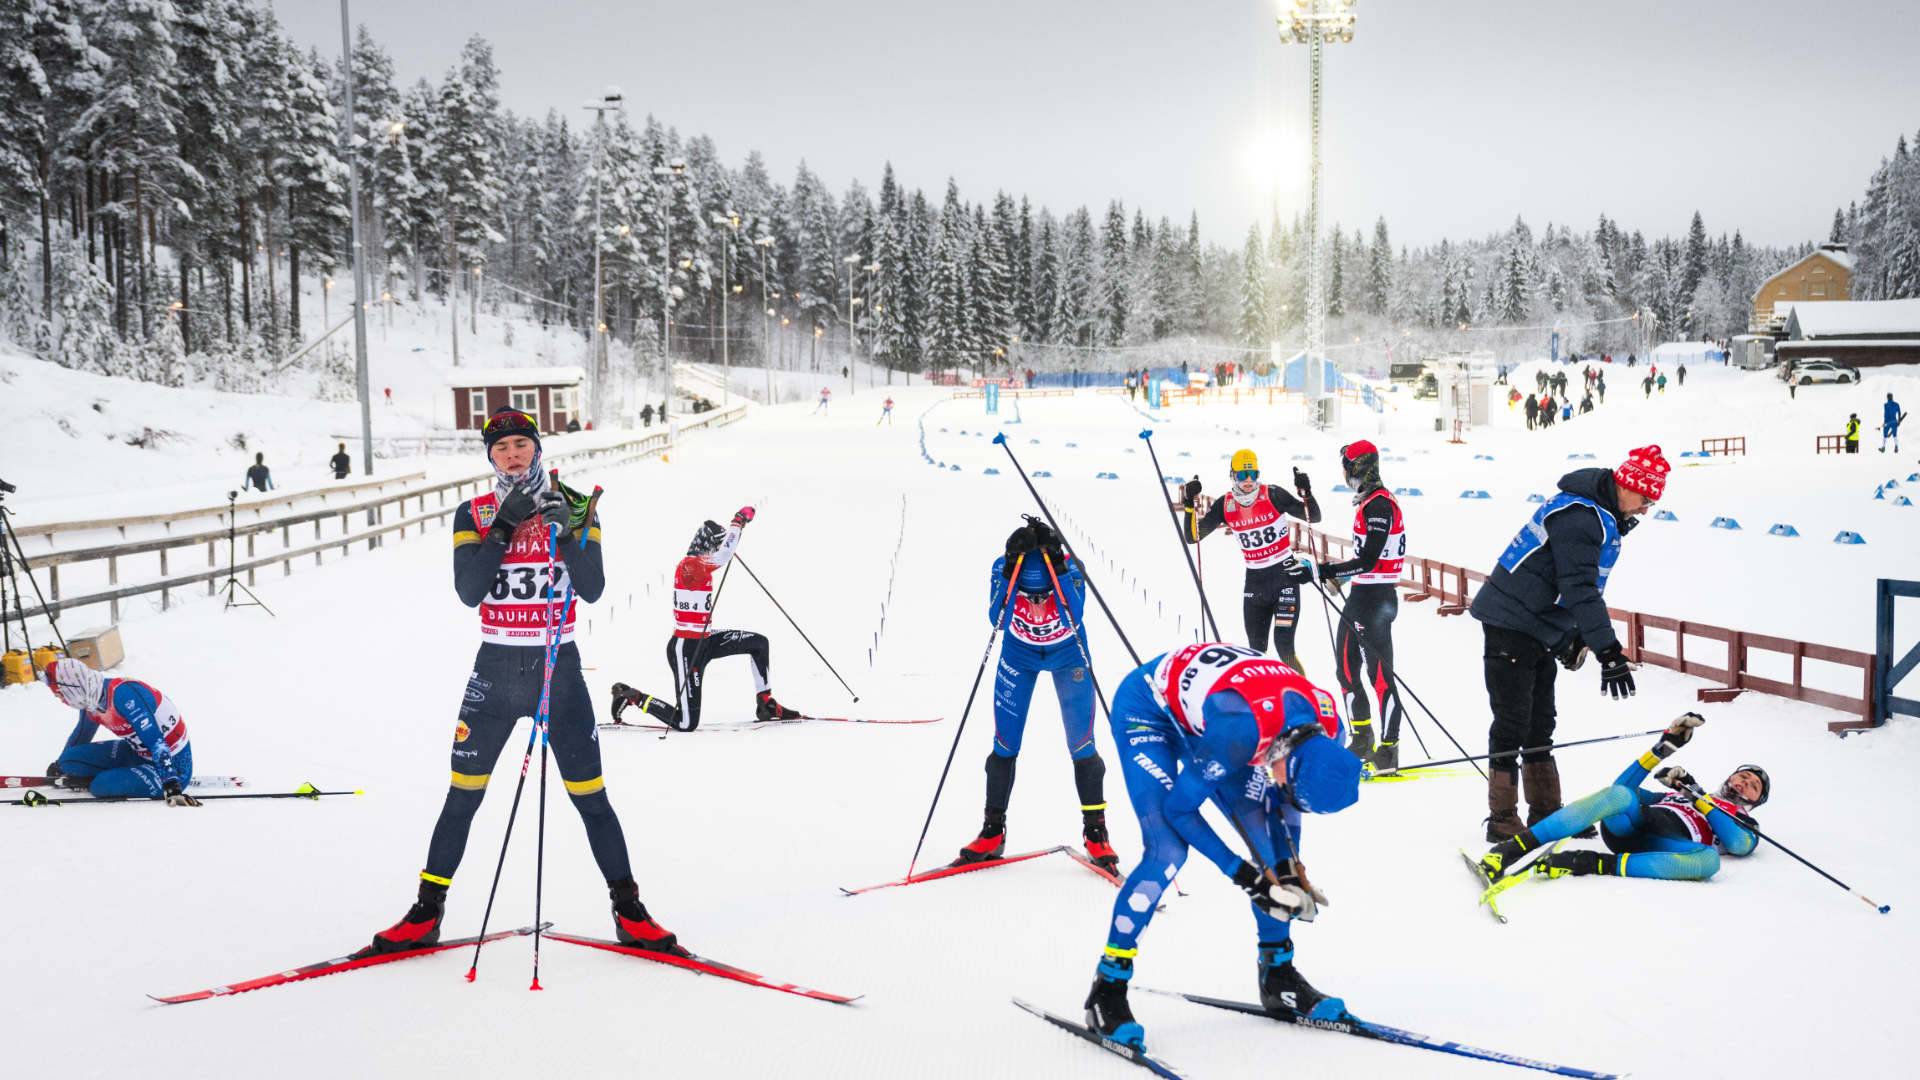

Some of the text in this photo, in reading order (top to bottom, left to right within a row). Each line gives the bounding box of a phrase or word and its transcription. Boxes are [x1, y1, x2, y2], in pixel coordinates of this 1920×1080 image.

[1239, 526, 1277, 549] 838
[490, 566, 562, 600] 832
[488, 610, 563, 623] BAUHAUS
[1295, 1015, 1350, 1033] SALOMON
